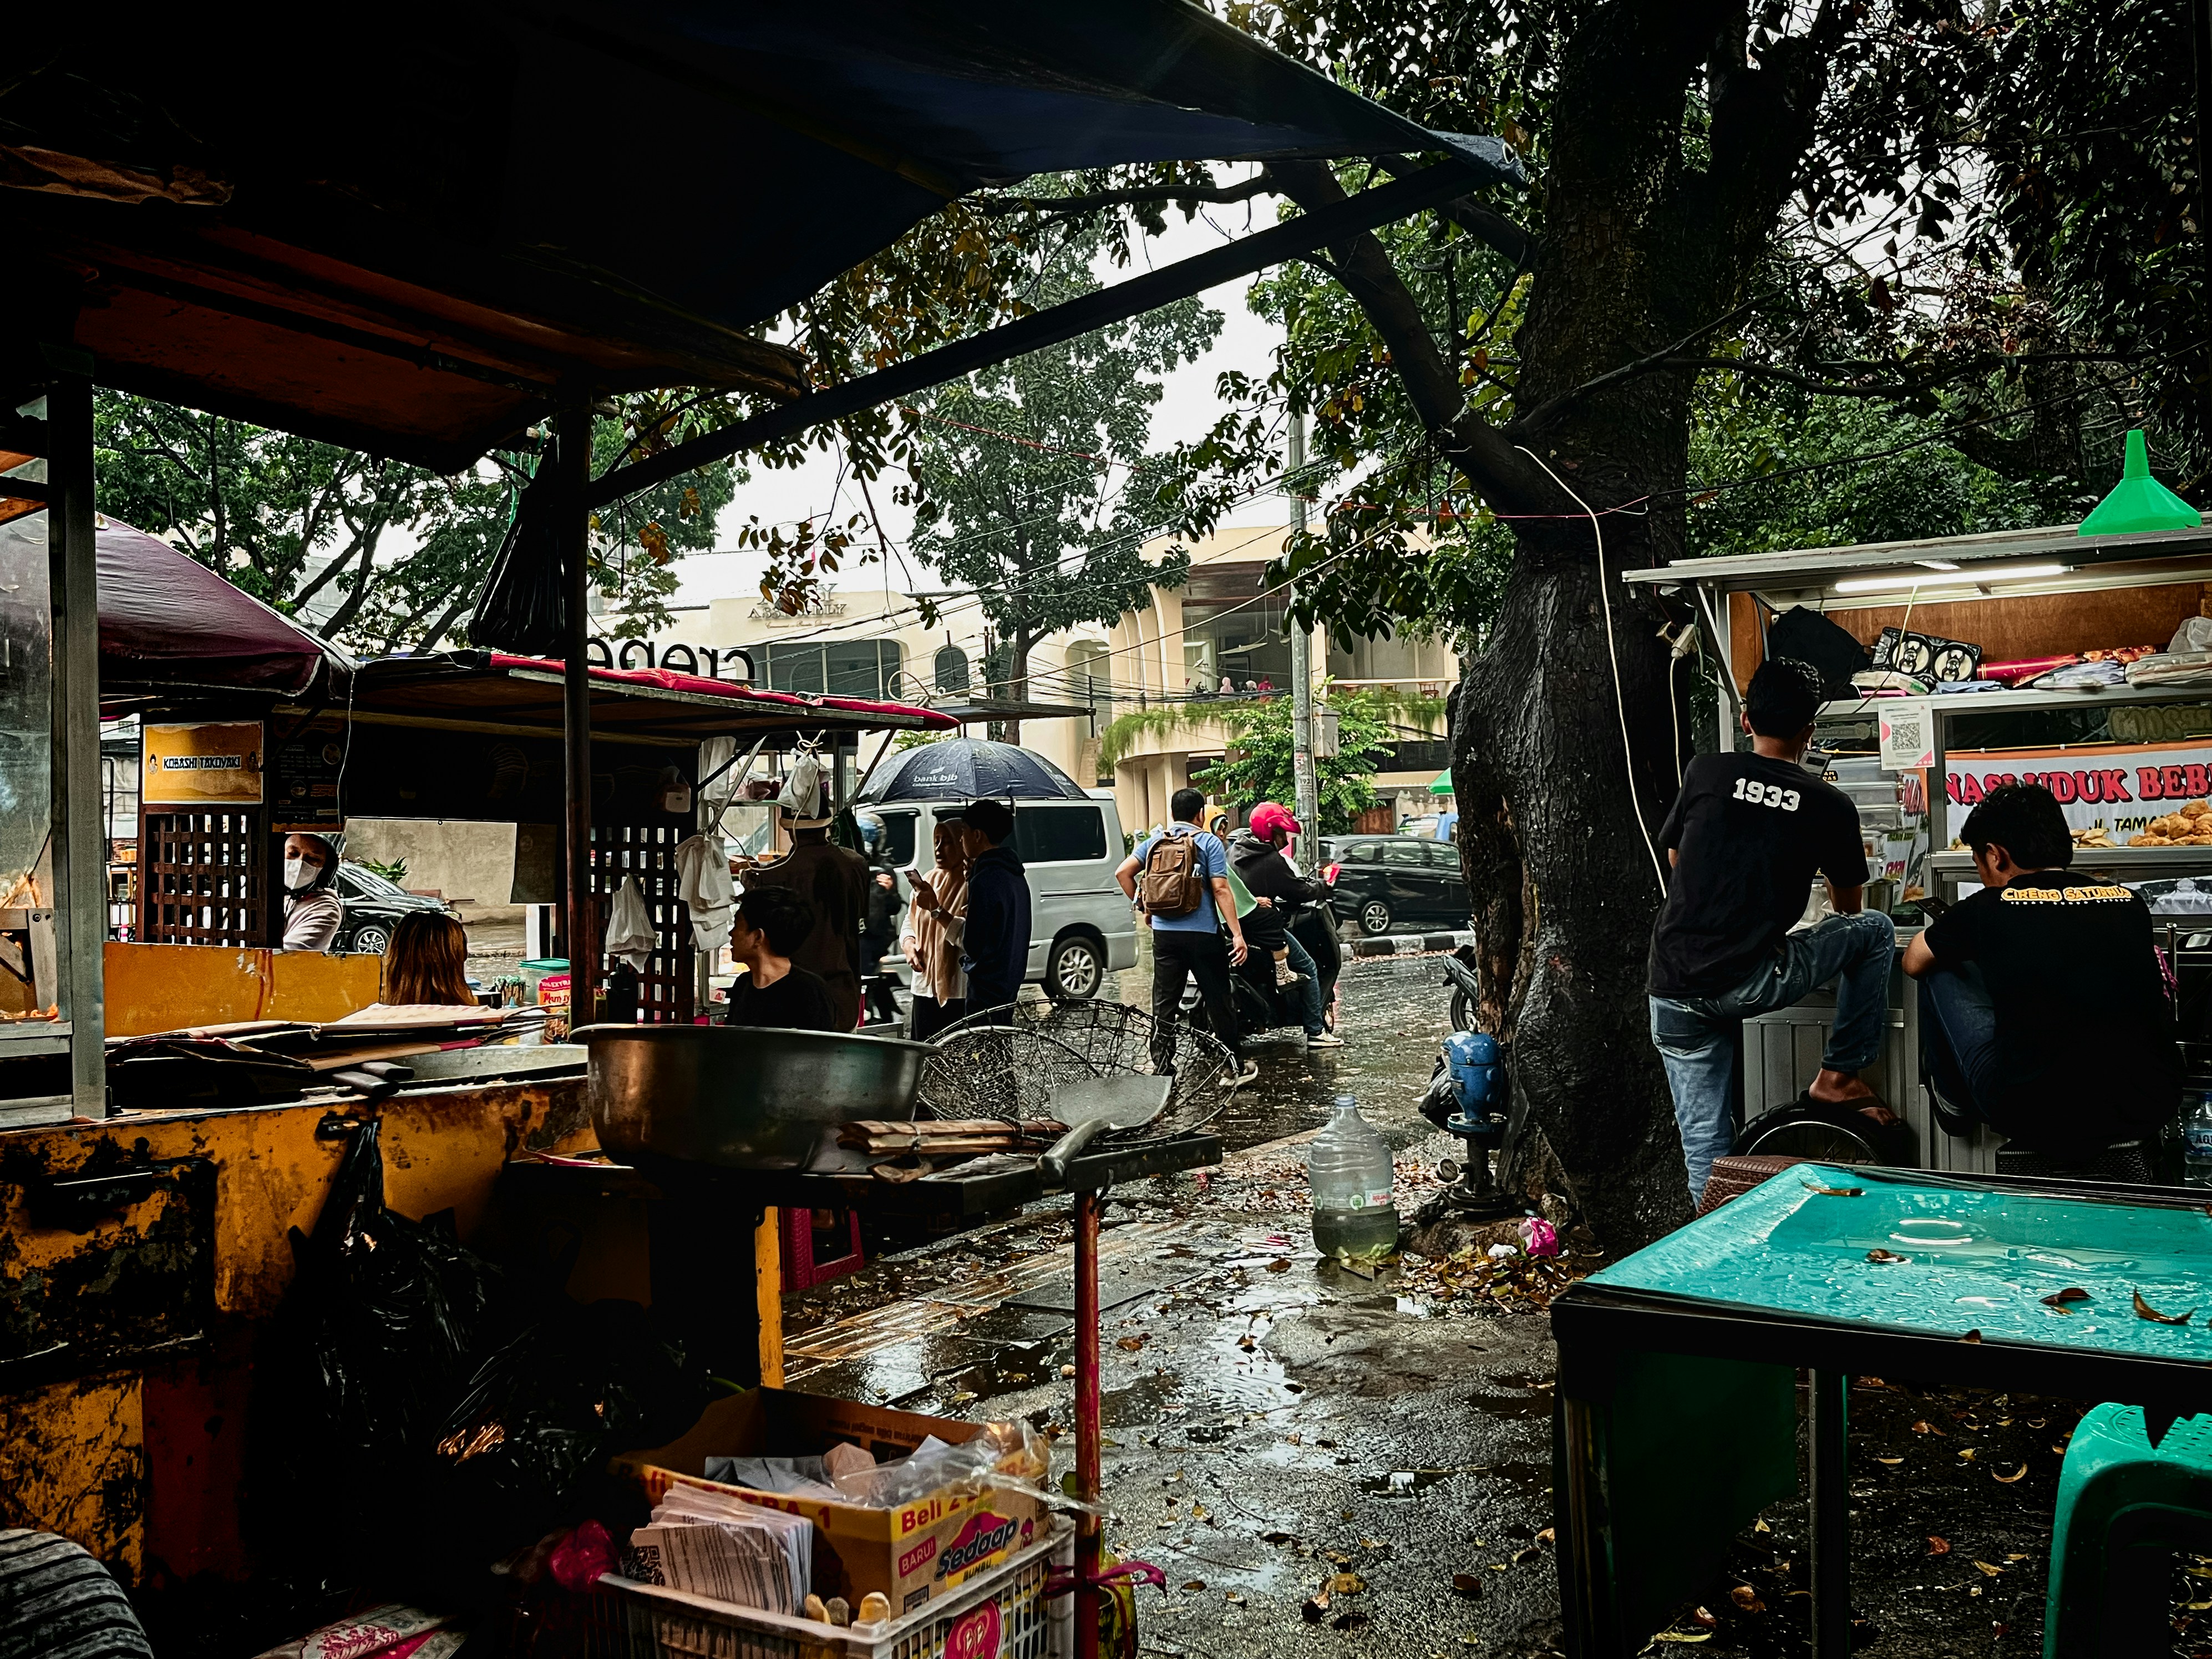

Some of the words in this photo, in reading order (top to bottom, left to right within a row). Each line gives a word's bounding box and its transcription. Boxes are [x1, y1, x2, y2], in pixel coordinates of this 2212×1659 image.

[164, 758, 197, 769] KOBASHI
[200, 757, 241, 768] TAKOYAKI
[1733, 778, 1800, 811] 1933
[2135, 763, 2212, 801] BEB
[2002, 888, 2062, 901] CIRENG
[2064, 887, 2132, 900] SATURNUS
[2196, 1134, 2212, 1145] AQ
[818, 1505, 830, 1529] 1
[901, 1498, 941, 1534] Beli
[902, 1541, 934, 1573] BARU!
[935, 1517, 1019, 1581] Sedaap
[963, 1558, 992, 1581] BUMBU
